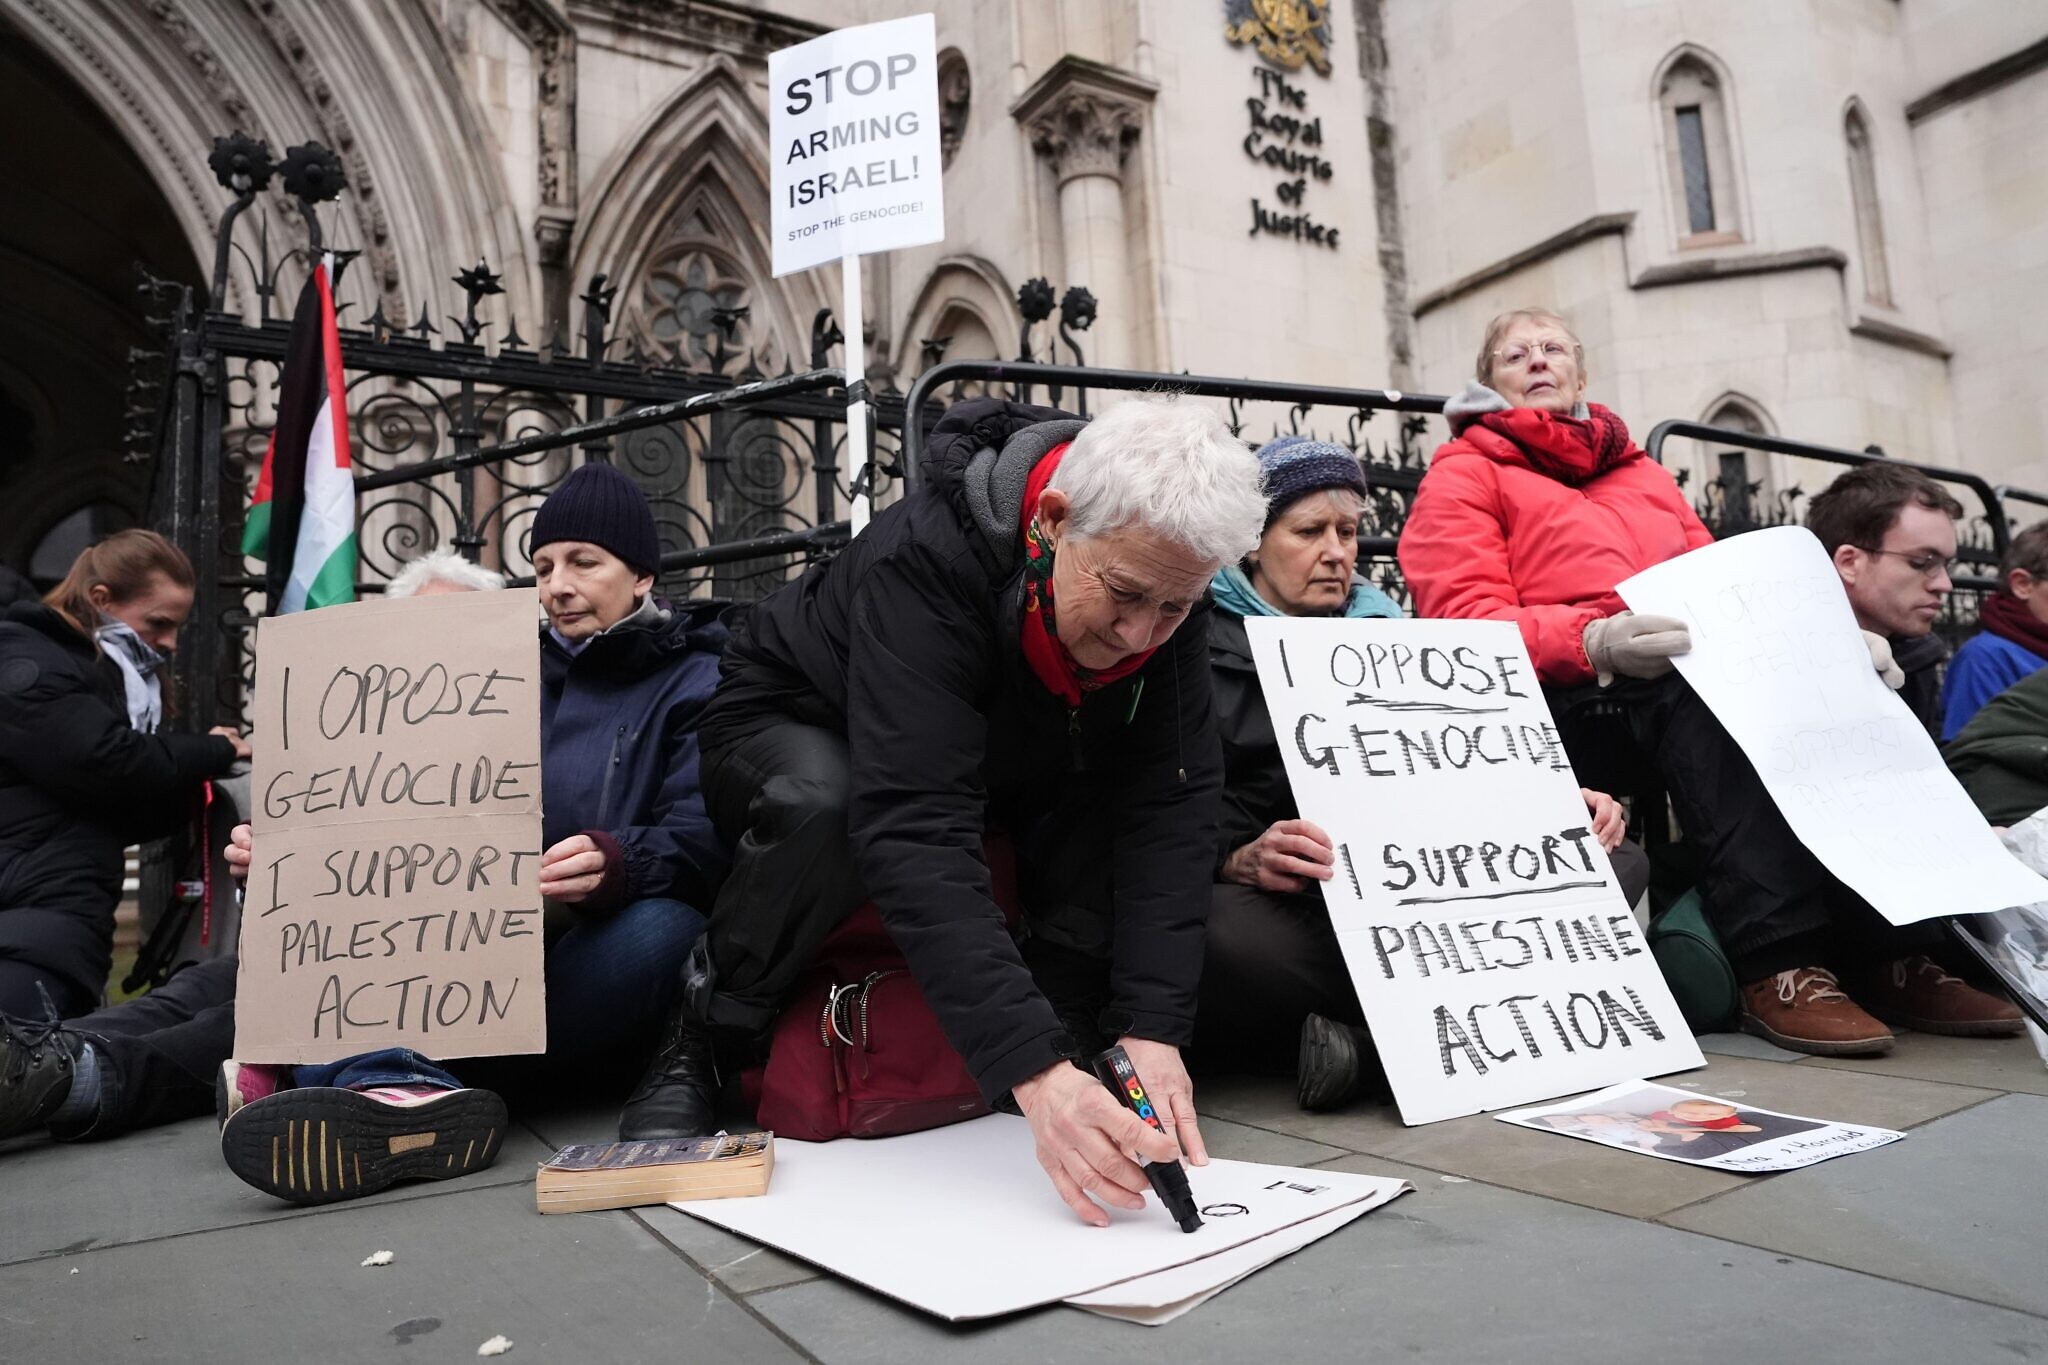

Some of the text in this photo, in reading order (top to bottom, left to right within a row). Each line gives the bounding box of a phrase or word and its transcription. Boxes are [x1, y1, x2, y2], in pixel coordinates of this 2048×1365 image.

[785, 53, 917, 116] STOP
[1253, 66, 1306, 110] The
[786, 111, 919, 166] ARMING
[1247, 97, 1322, 146] Royal
[788, 155, 919, 209] ISRAEL!
[1243, 131, 1333, 181] Courts
[788, 200, 924, 242] STOP THE GENOCIDE!
[1249, 198, 1339, 249] Justice
[1276, 179, 1306, 206] of
[1278, 638, 1530, 700] I OPPOSE
[282, 663, 526, 750] I OPPOSE
[1294, 713, 1571, 777] GENOCIDE
[264, 748, 539, 820] GENOCIDE
[260, 843, 540, 919] I SUPPORT
[1338, 825, 1597, 901] I SUPPORT
[281, 907, 540, 975] PALESTINE
[1368, 915, 1643, 981] PALESTINE
[314, 975, 520, 1041] ACTION
[1432, 985, 1667, 1080] ACTION
